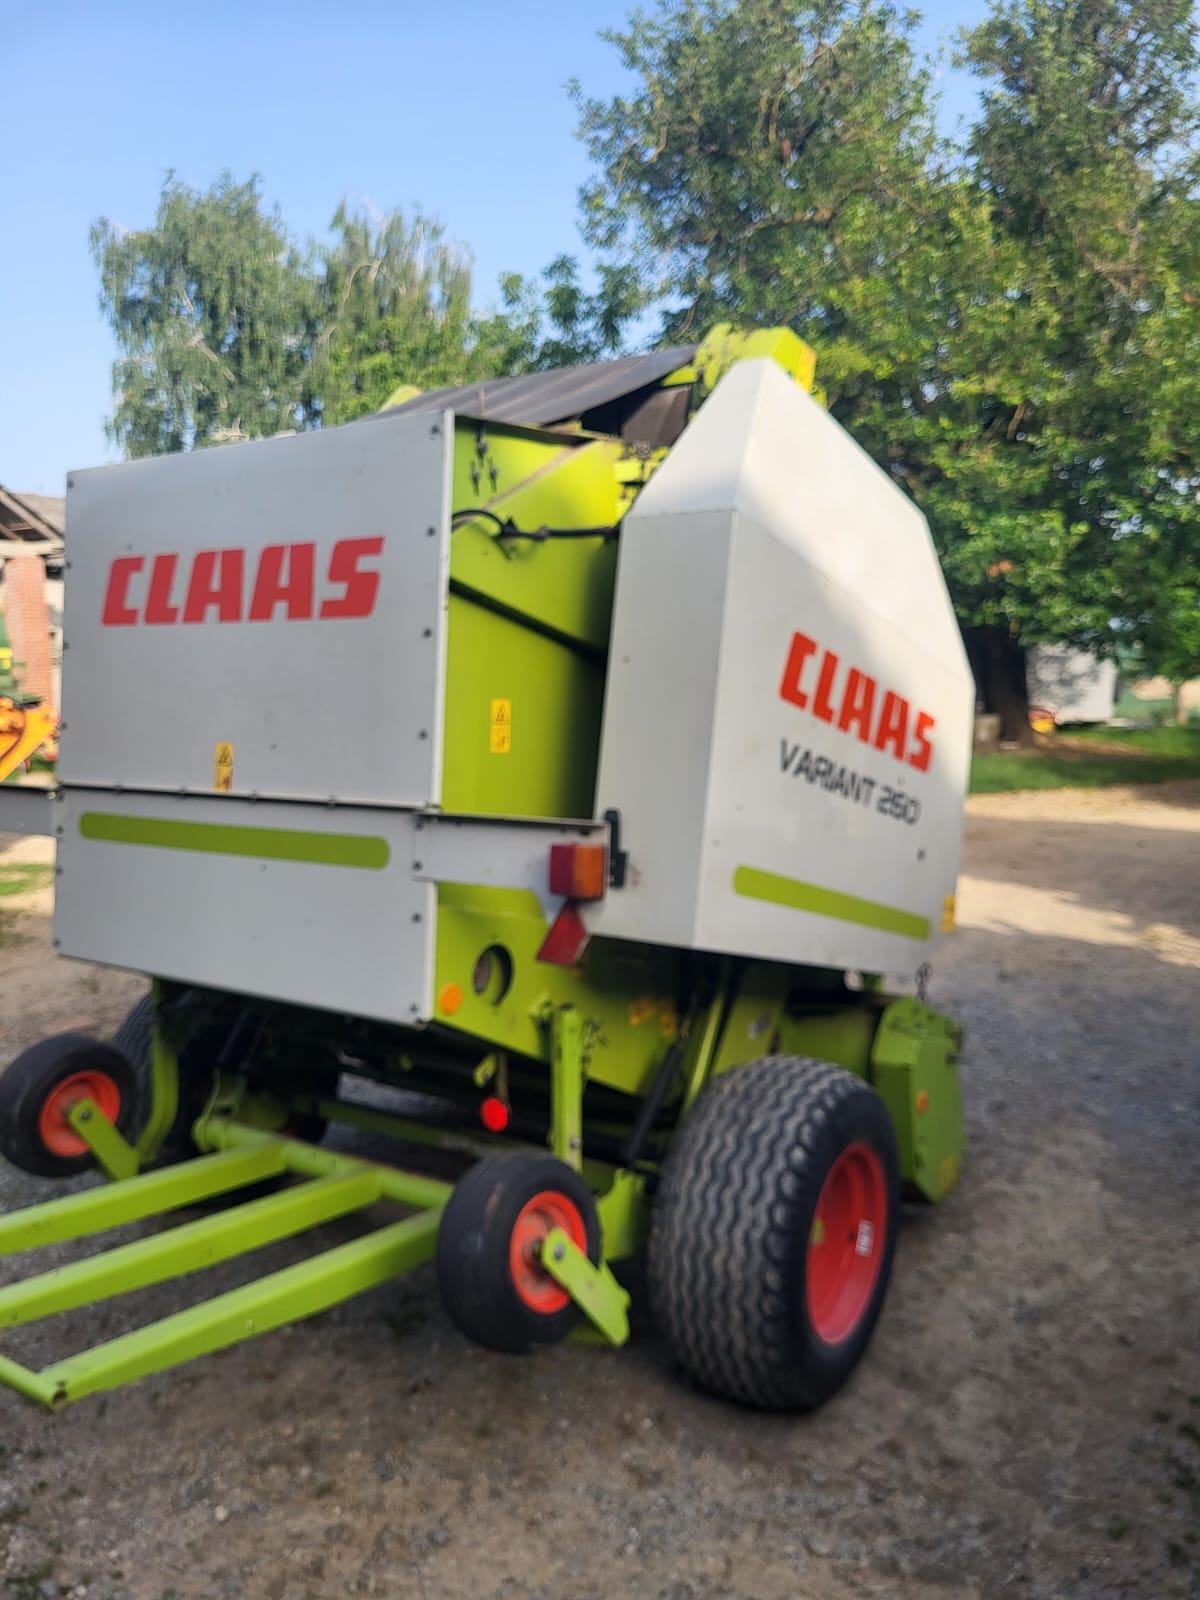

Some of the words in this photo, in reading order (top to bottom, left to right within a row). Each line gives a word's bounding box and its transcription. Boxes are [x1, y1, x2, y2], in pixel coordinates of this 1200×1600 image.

[101, 535, 385, 626] CLAAS
[779, 631, 936, 773] CLAAS
[780, 738, 876, 806] VARIANT
